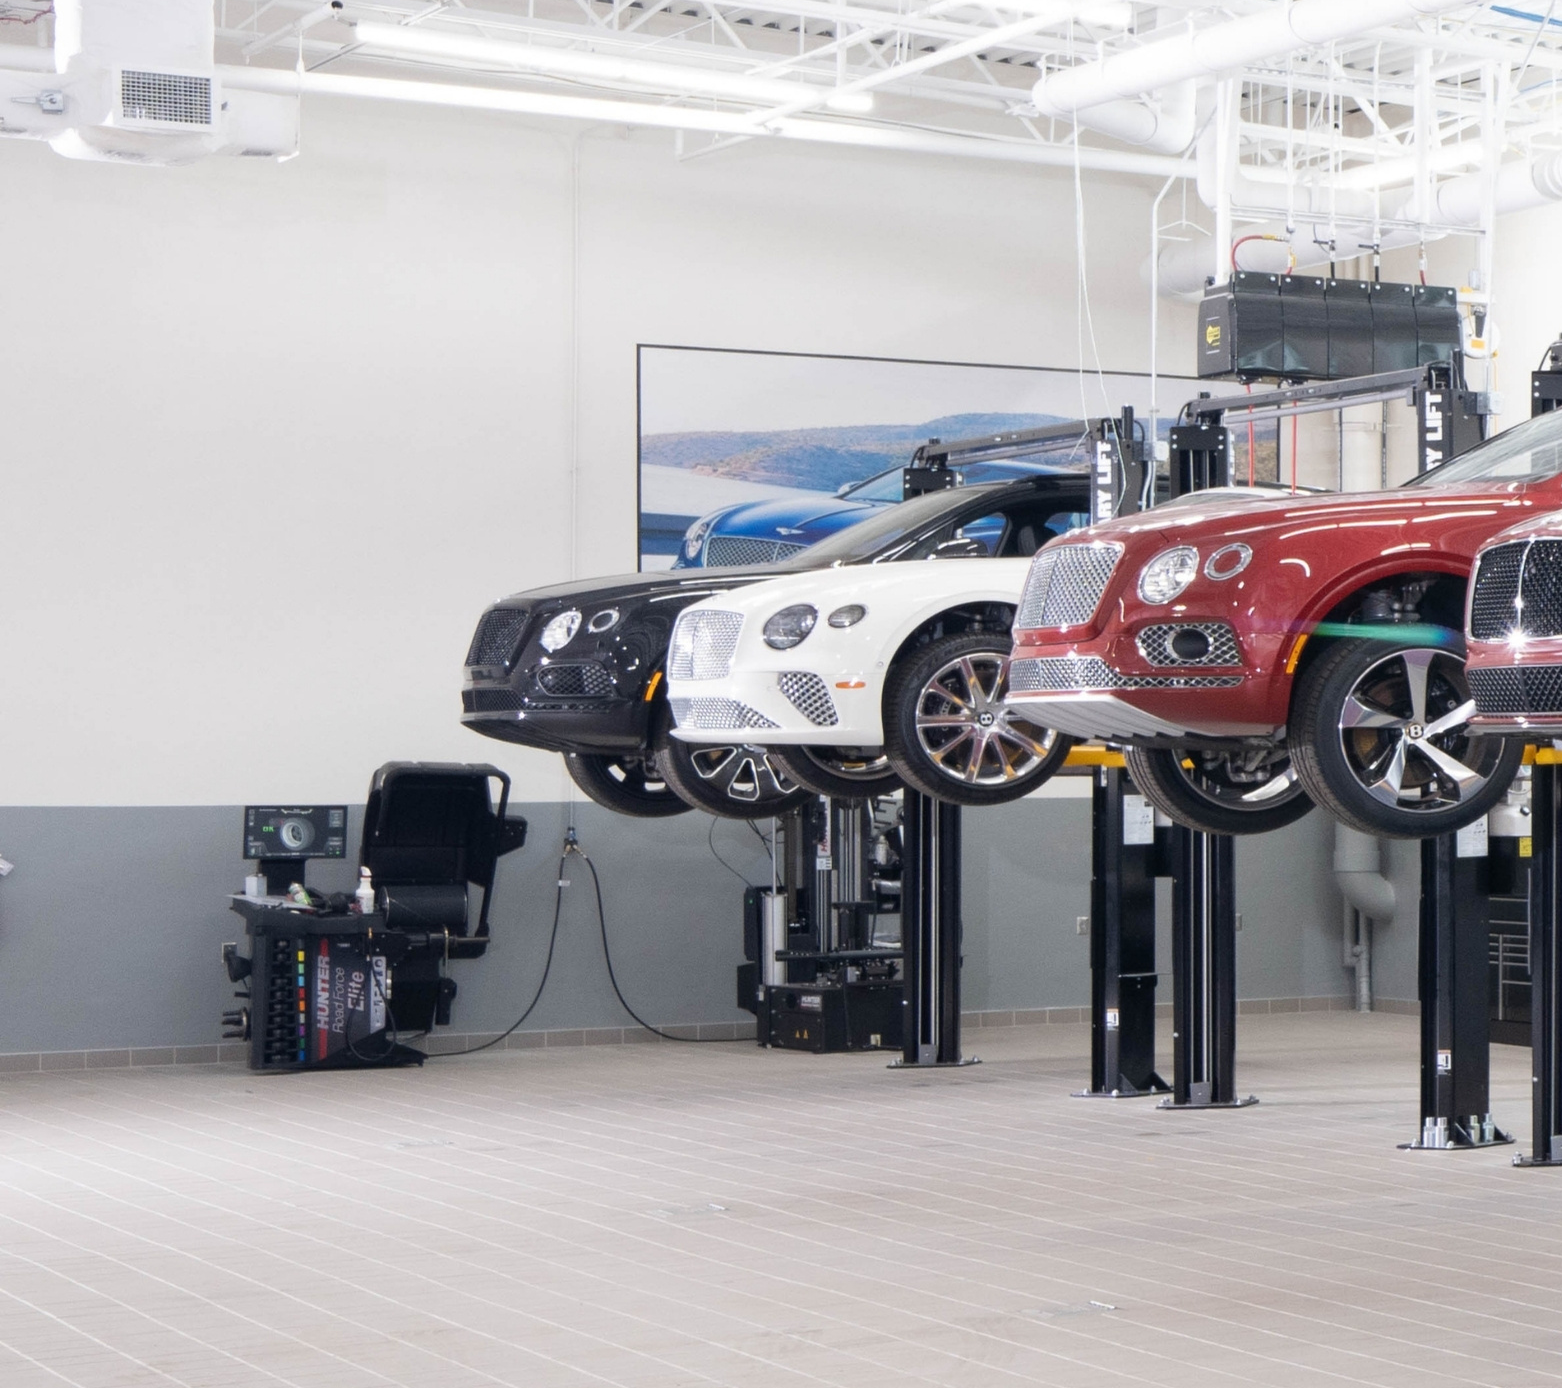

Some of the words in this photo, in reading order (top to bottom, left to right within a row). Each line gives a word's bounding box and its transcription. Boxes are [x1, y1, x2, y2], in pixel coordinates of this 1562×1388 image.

[1425, 391, 1442, 441] LIFT
[1096, 440, 1112, 484] LIFT
[317, 955, 330, 1029] HUNTER
[347, 971, 365, 1011] Elite
